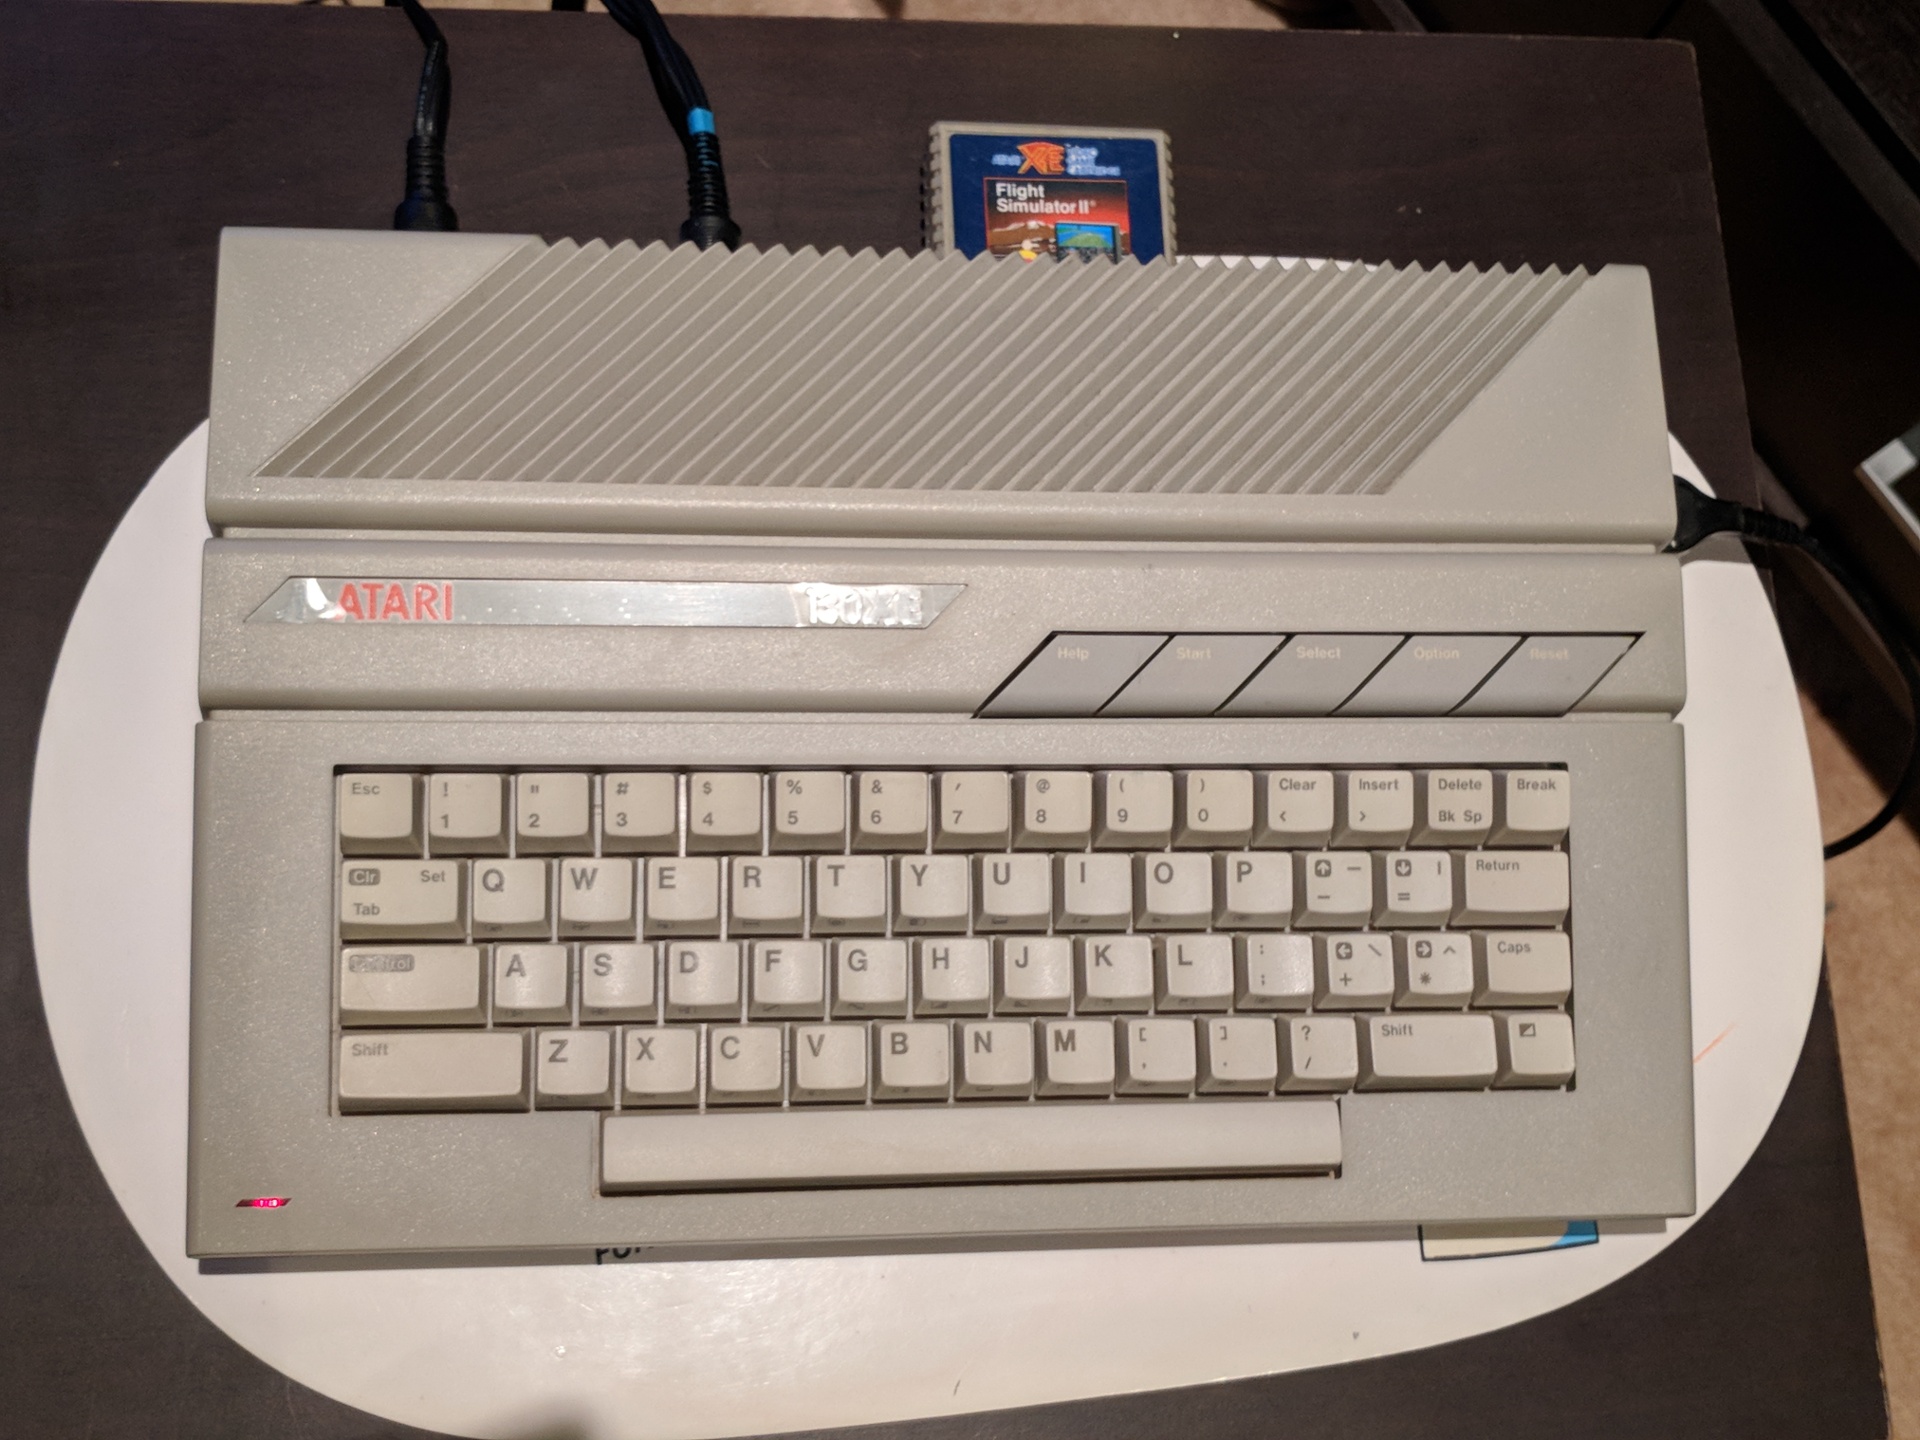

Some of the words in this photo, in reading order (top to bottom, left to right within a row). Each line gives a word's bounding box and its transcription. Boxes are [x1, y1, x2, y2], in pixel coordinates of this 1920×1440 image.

[1016, 142, 1065, 174] XE
[995, 182, 1045, 200] Flight
[996, 198, 1076, 214] Simulator
[337, 583, 454, 621] ATARI
[1057, 647, 1089, 660] Help
[1176, 647, 1211, 659] Start
[1296, 646, 1341, 659] Select
[1414, 647, 1460, 659] Option
[1530, 648, 1569, 660] Reset
[352, 782, 380, 796] Esc
[1278, 778, 1316, 790] Clear
[1358, 778, 1398, 790] Insert
[1438, 778, 1482, 790] Delete
[1516, 778, 1556, 790] Break
[440, 814, 448, 828] 1
[528, 814, 540, 828] 2
[616, 812, 628, 828] 3
[702, 812, 714, 826] 4
[788, 810, 798, 826] 5
[870, 810, 882, 824] 6
[952, 810, 962, 824] 7
[1036, 808, 1046, 824] 8
[1118, 808, 1128, 824] 9
[1198, 808, 1210, 822] 0
[1438, 810, 1456, 822] Bk
[1464, 810, 1482, 824] Sp
[992, 862, 1010, 886] U
[1080, 862, 1086, 884] I
[1154, 862, 1174, 884] O
[1236, 860, 1252, 884] P
[1476, 858, 1520, 872] Return
[353, 871, 378, 884] Clr
[420, 870, 446, 882] Set
[482, 868, 504, 892] Q
[570, 868, 598, 890] W
[658, 866, 676, 890] E
[744, 866, 762, 888] R
[826, 864, 846, 886] T
[910, 864, 928, 886] Y
[352, 902, 380, 916] Tab
[1014, 946, 1028, 968] J
[1094, 944, 1112, 968] K
[1178, 944, 1192, 966] L
[1496, 940, 1532, 956] Caps
[504, 954, 526, 978] A
[592, 952, 612, 976] S
[678, 950, 698, 974] D
[764, 950, 782, 972] F
[848, 948, 868, 972] G
[932, 948, 950, 970] H
[1054, 1028, 1076, 1052] M
[1380, 1024, 1414, 1038] Shift
[352, 1042, 388, 1056] Shift
[548, 1038, 568, 1064] Z
[636, 1036, 654, 1060] X
[720, 1036, 740, 1060] C
[806, 1034, 824, 1058] V
[890, 1032, 908, 1056] B
[974, 1030, 992, 1054] N
